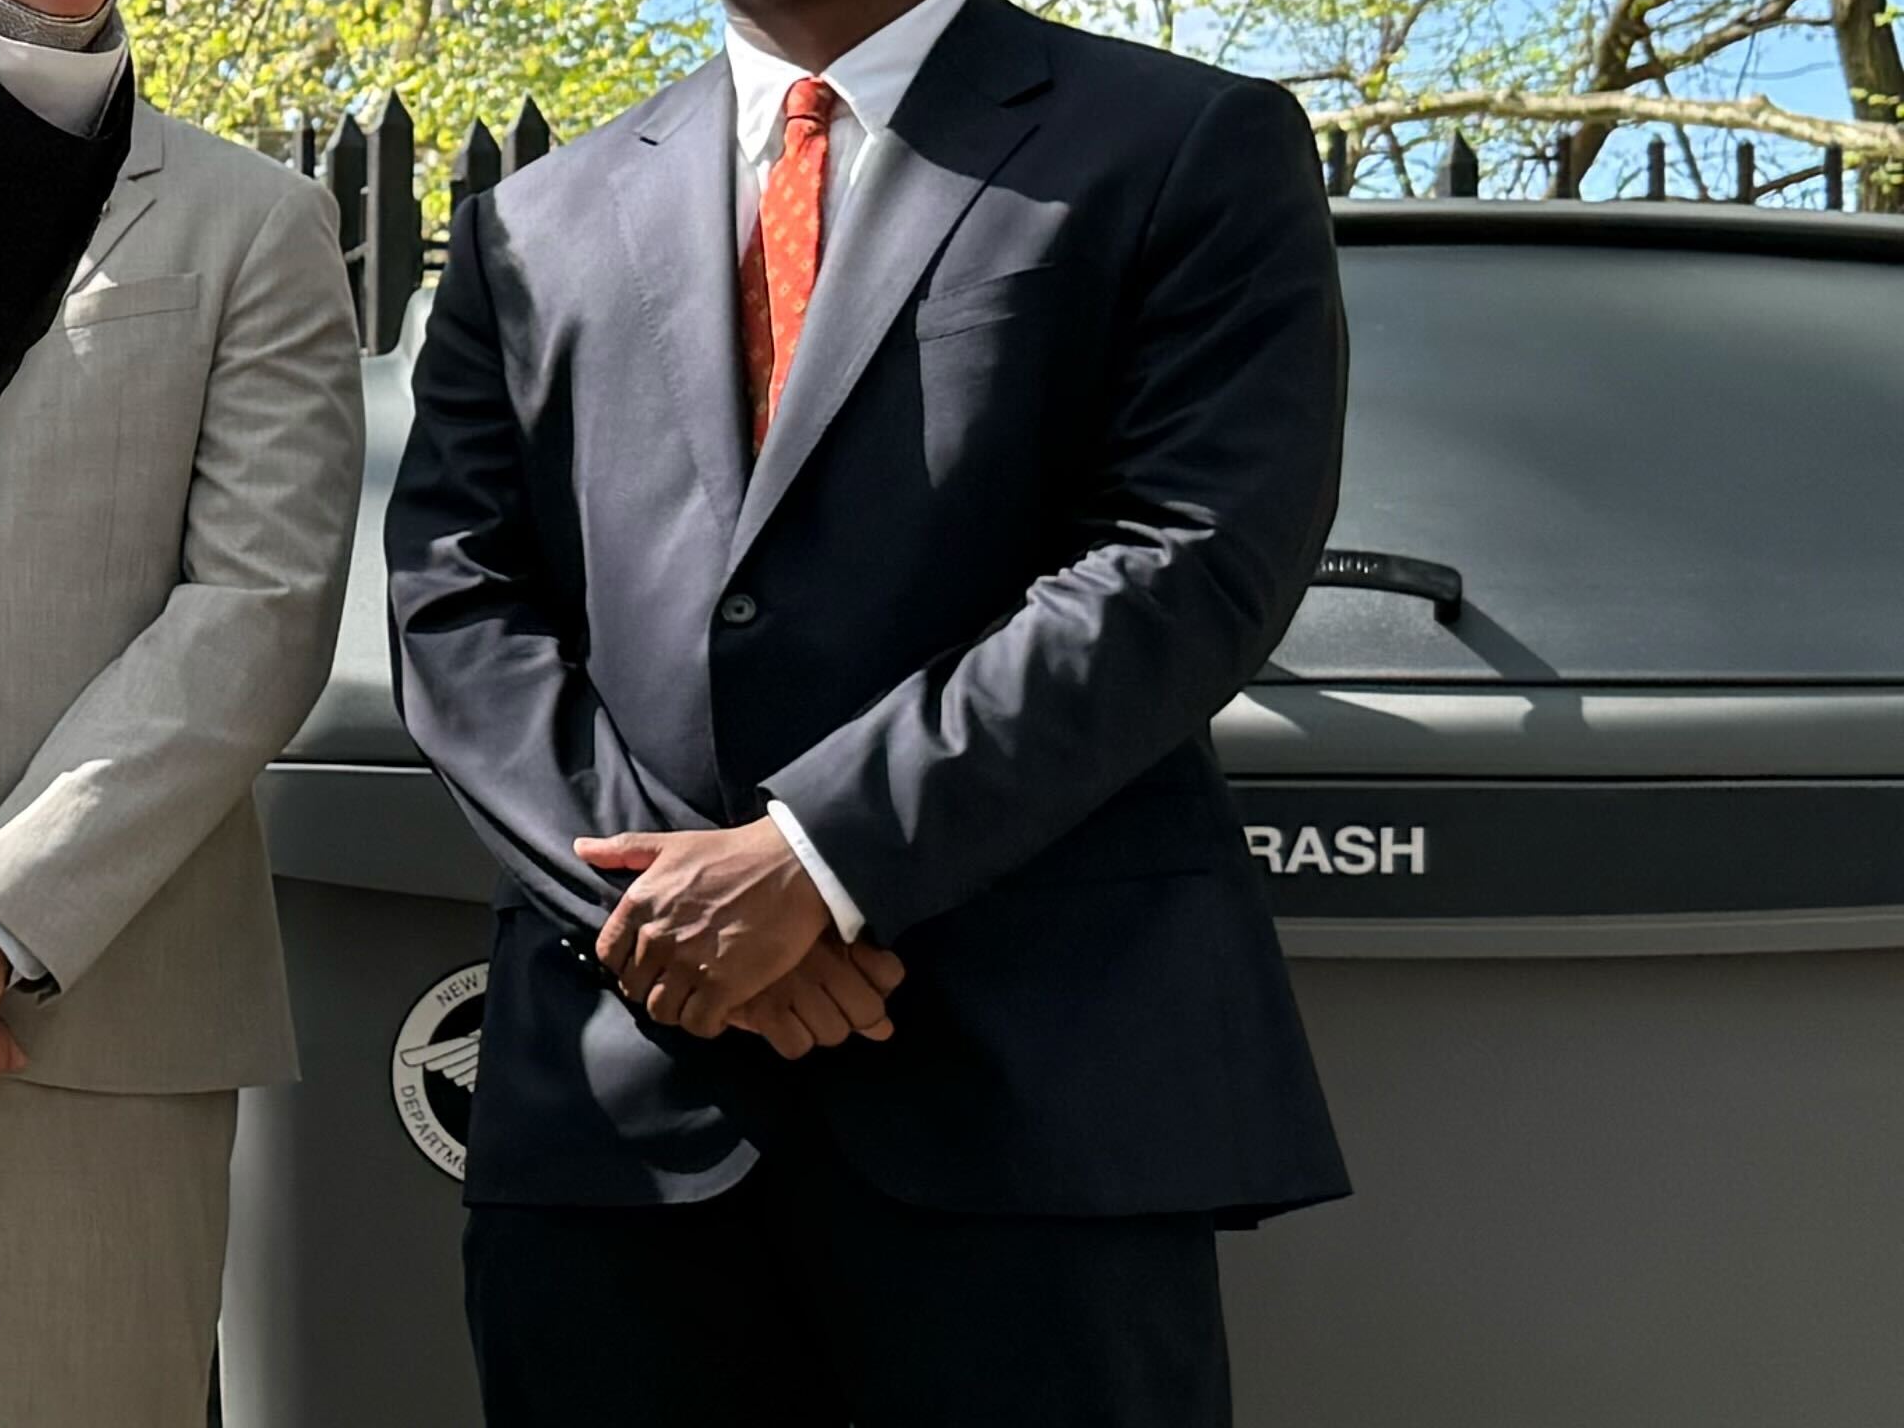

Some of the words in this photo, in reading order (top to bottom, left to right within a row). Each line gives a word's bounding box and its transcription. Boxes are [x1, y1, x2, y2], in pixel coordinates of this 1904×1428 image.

[1243, 825, 1425, 874] RASH
[436, 971, 479, 1008] NEW
[400, 1084, 465, 1174] DEPARTM
